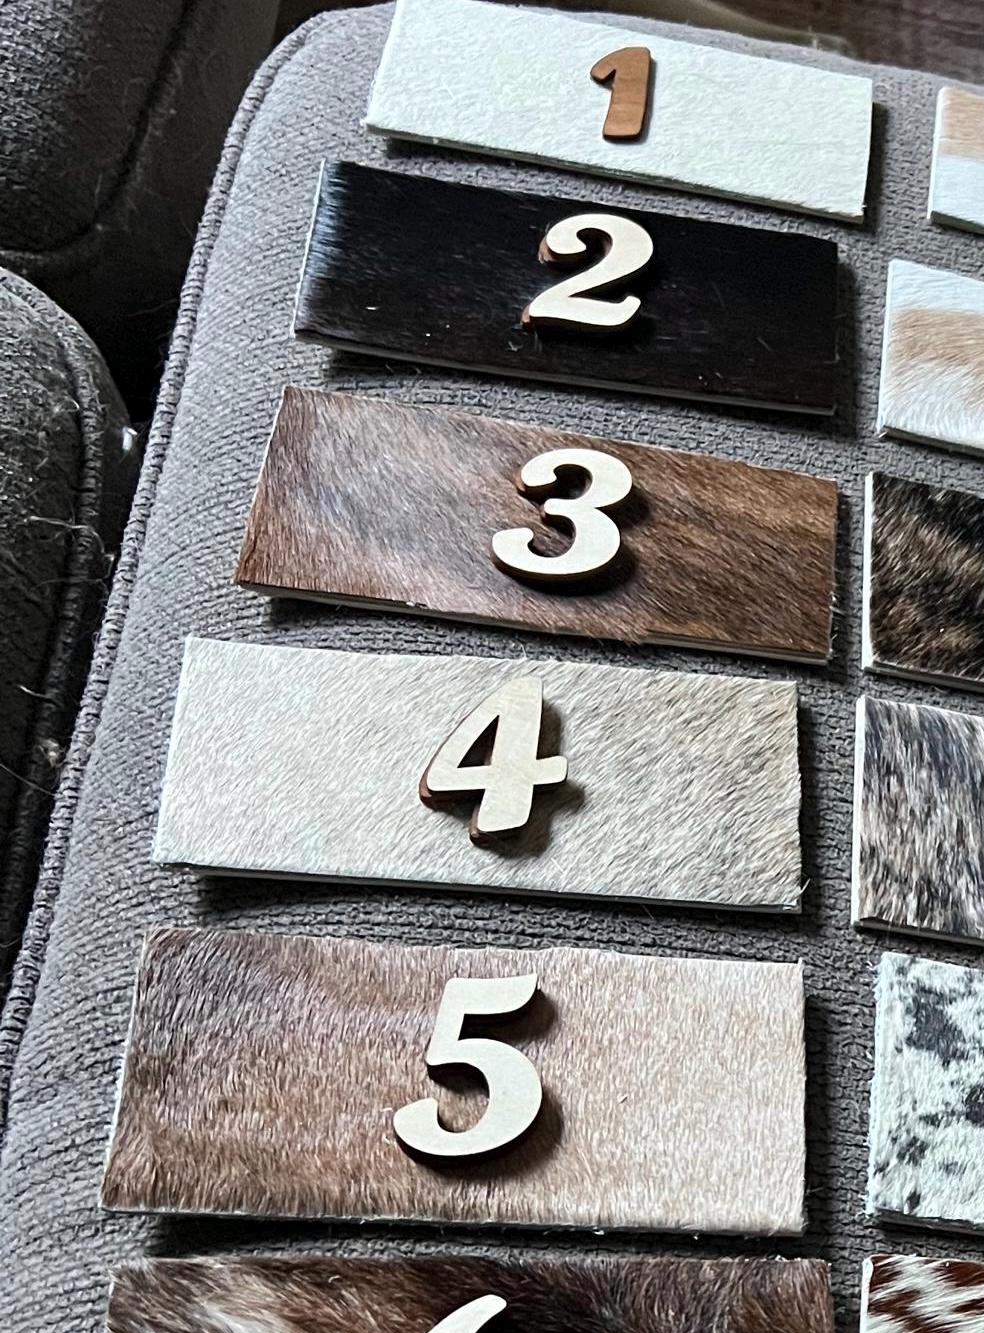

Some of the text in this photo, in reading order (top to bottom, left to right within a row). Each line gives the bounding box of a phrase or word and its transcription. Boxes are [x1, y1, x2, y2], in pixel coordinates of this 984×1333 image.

[591, 46, 655, 141] 1
[521, 214, 655, 330] 2
[491, 447, 634, 580] 3
[420, 678, 569, 838] 4
[393, 973, 543, 1158] 5
